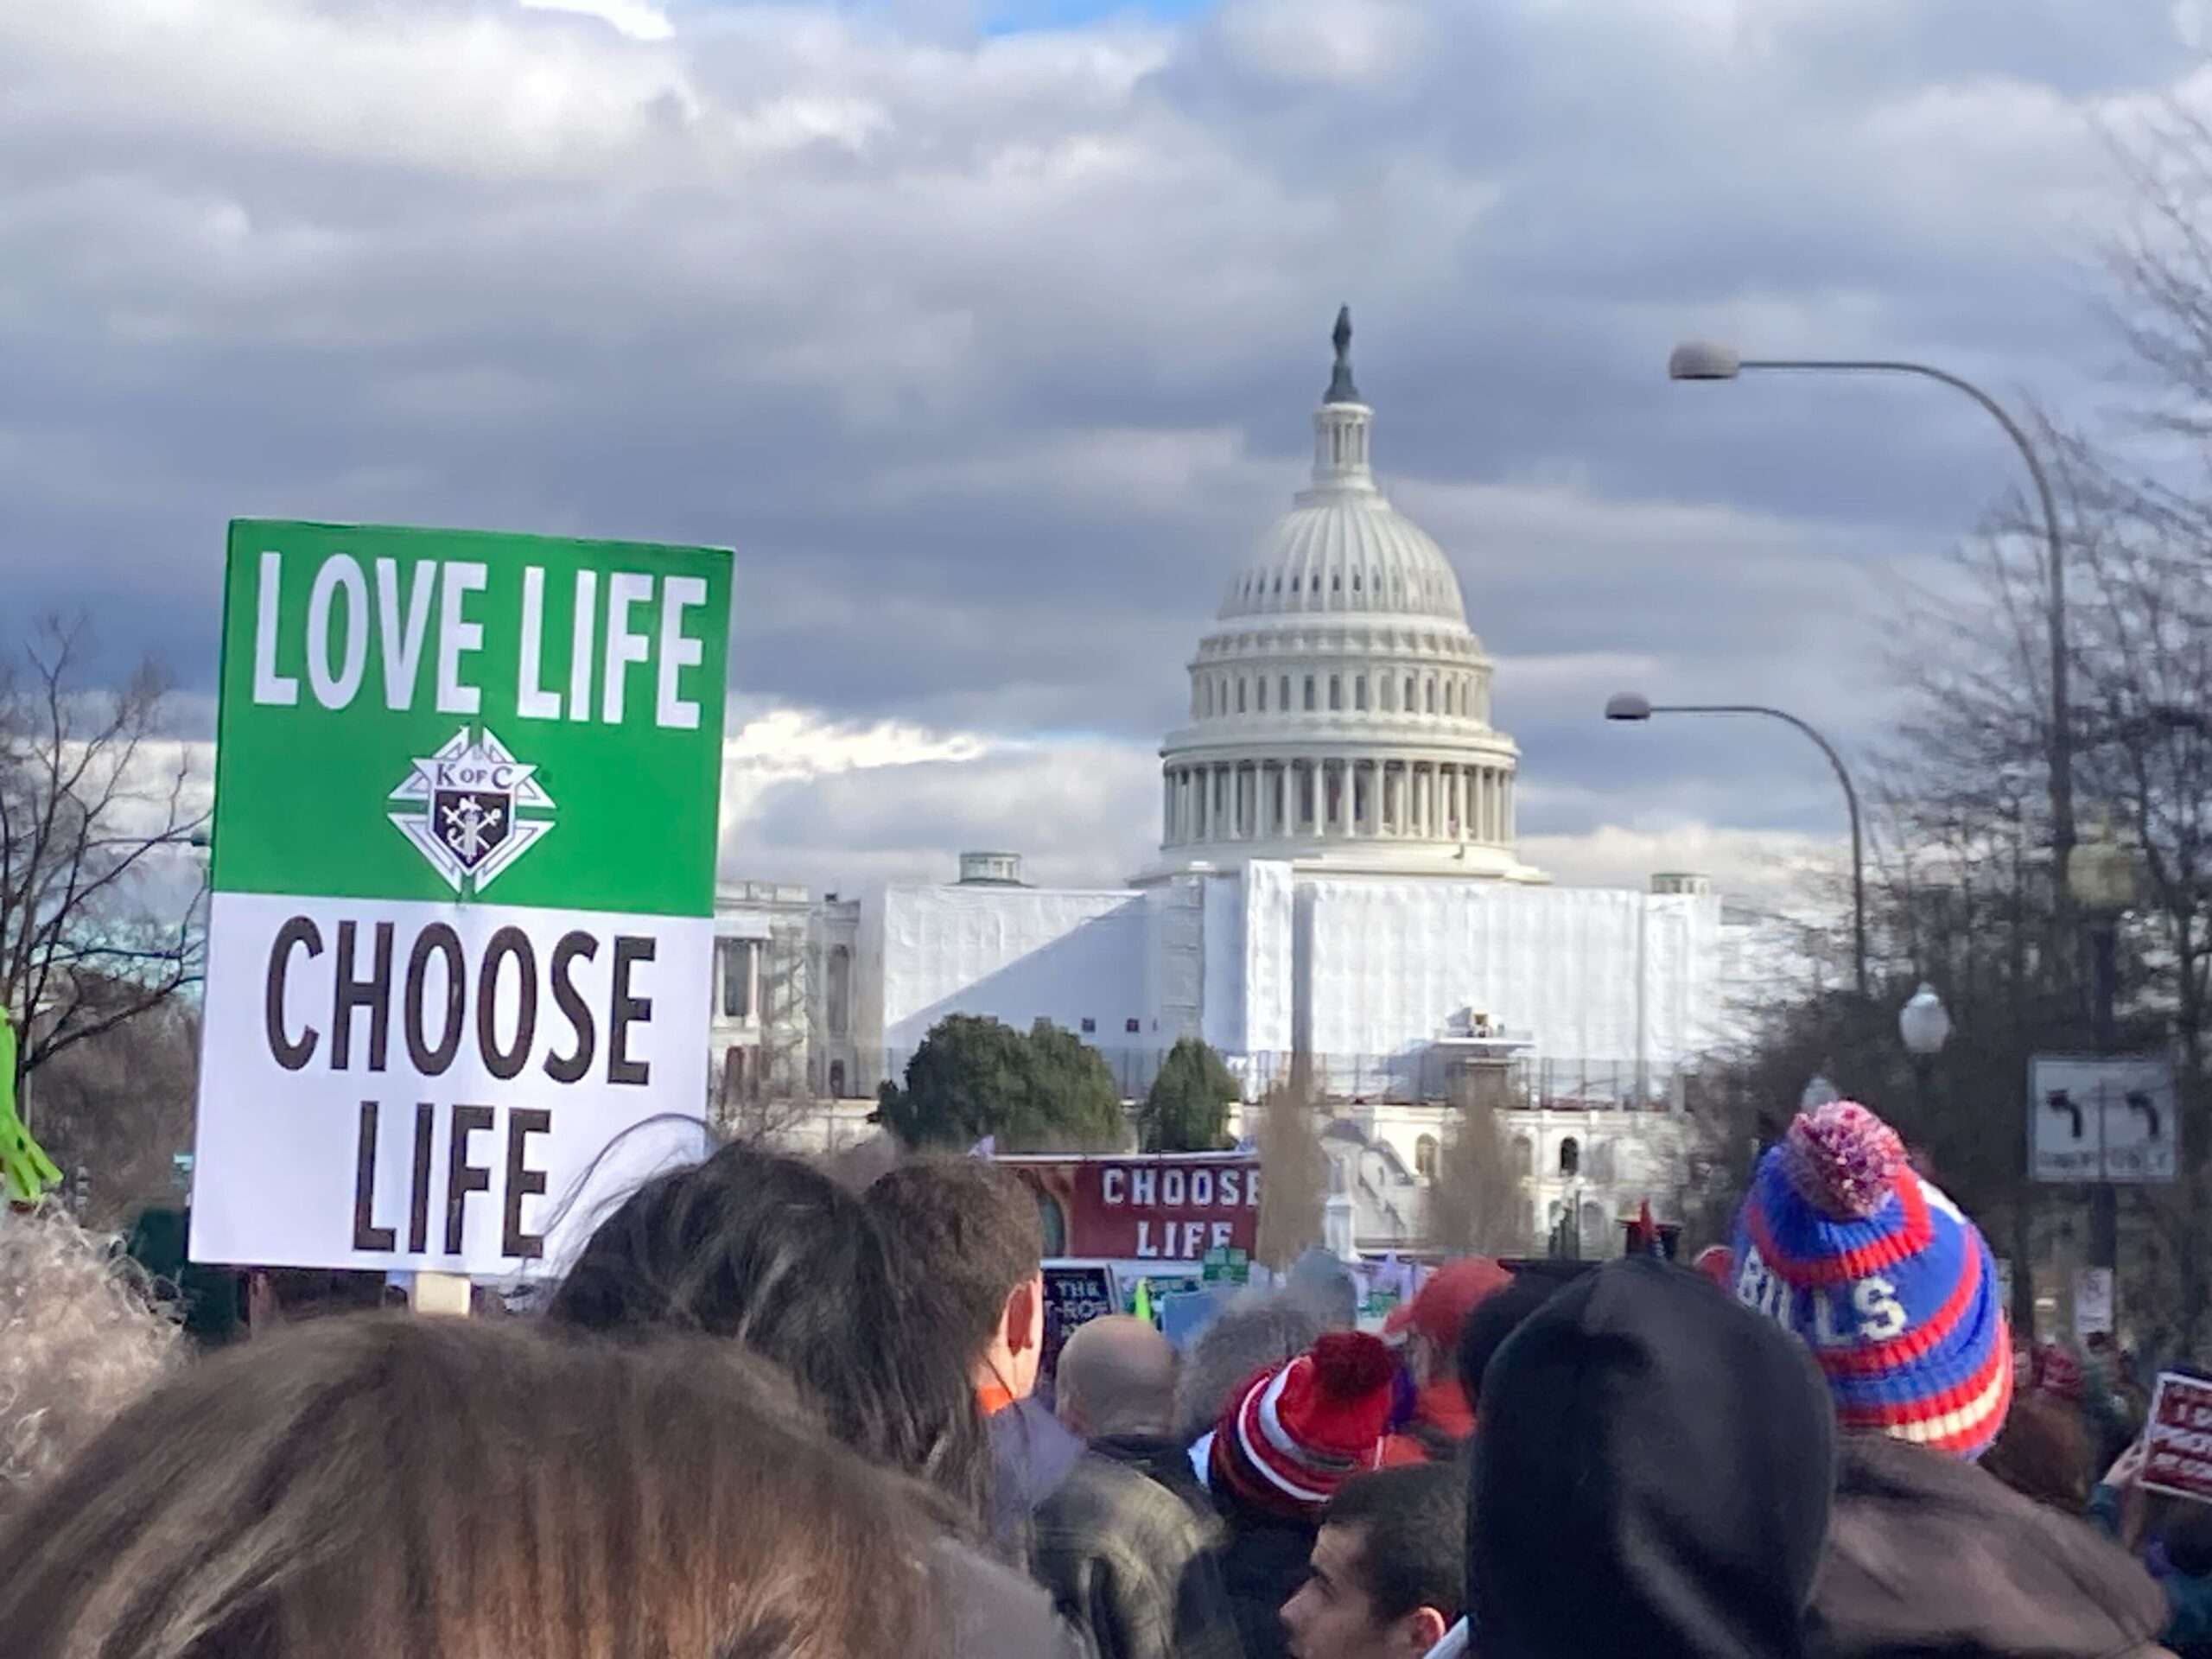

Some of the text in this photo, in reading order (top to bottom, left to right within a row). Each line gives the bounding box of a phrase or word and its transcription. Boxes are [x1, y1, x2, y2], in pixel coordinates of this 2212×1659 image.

[253, 551, 708, 730] LOVE LIFE
[436, 763, 456, 786] K
[492, 766, 513, 790] C
[266, 915, 657, 1085] CHOOSE
[351, 1101, 552, 1259] LIFE
